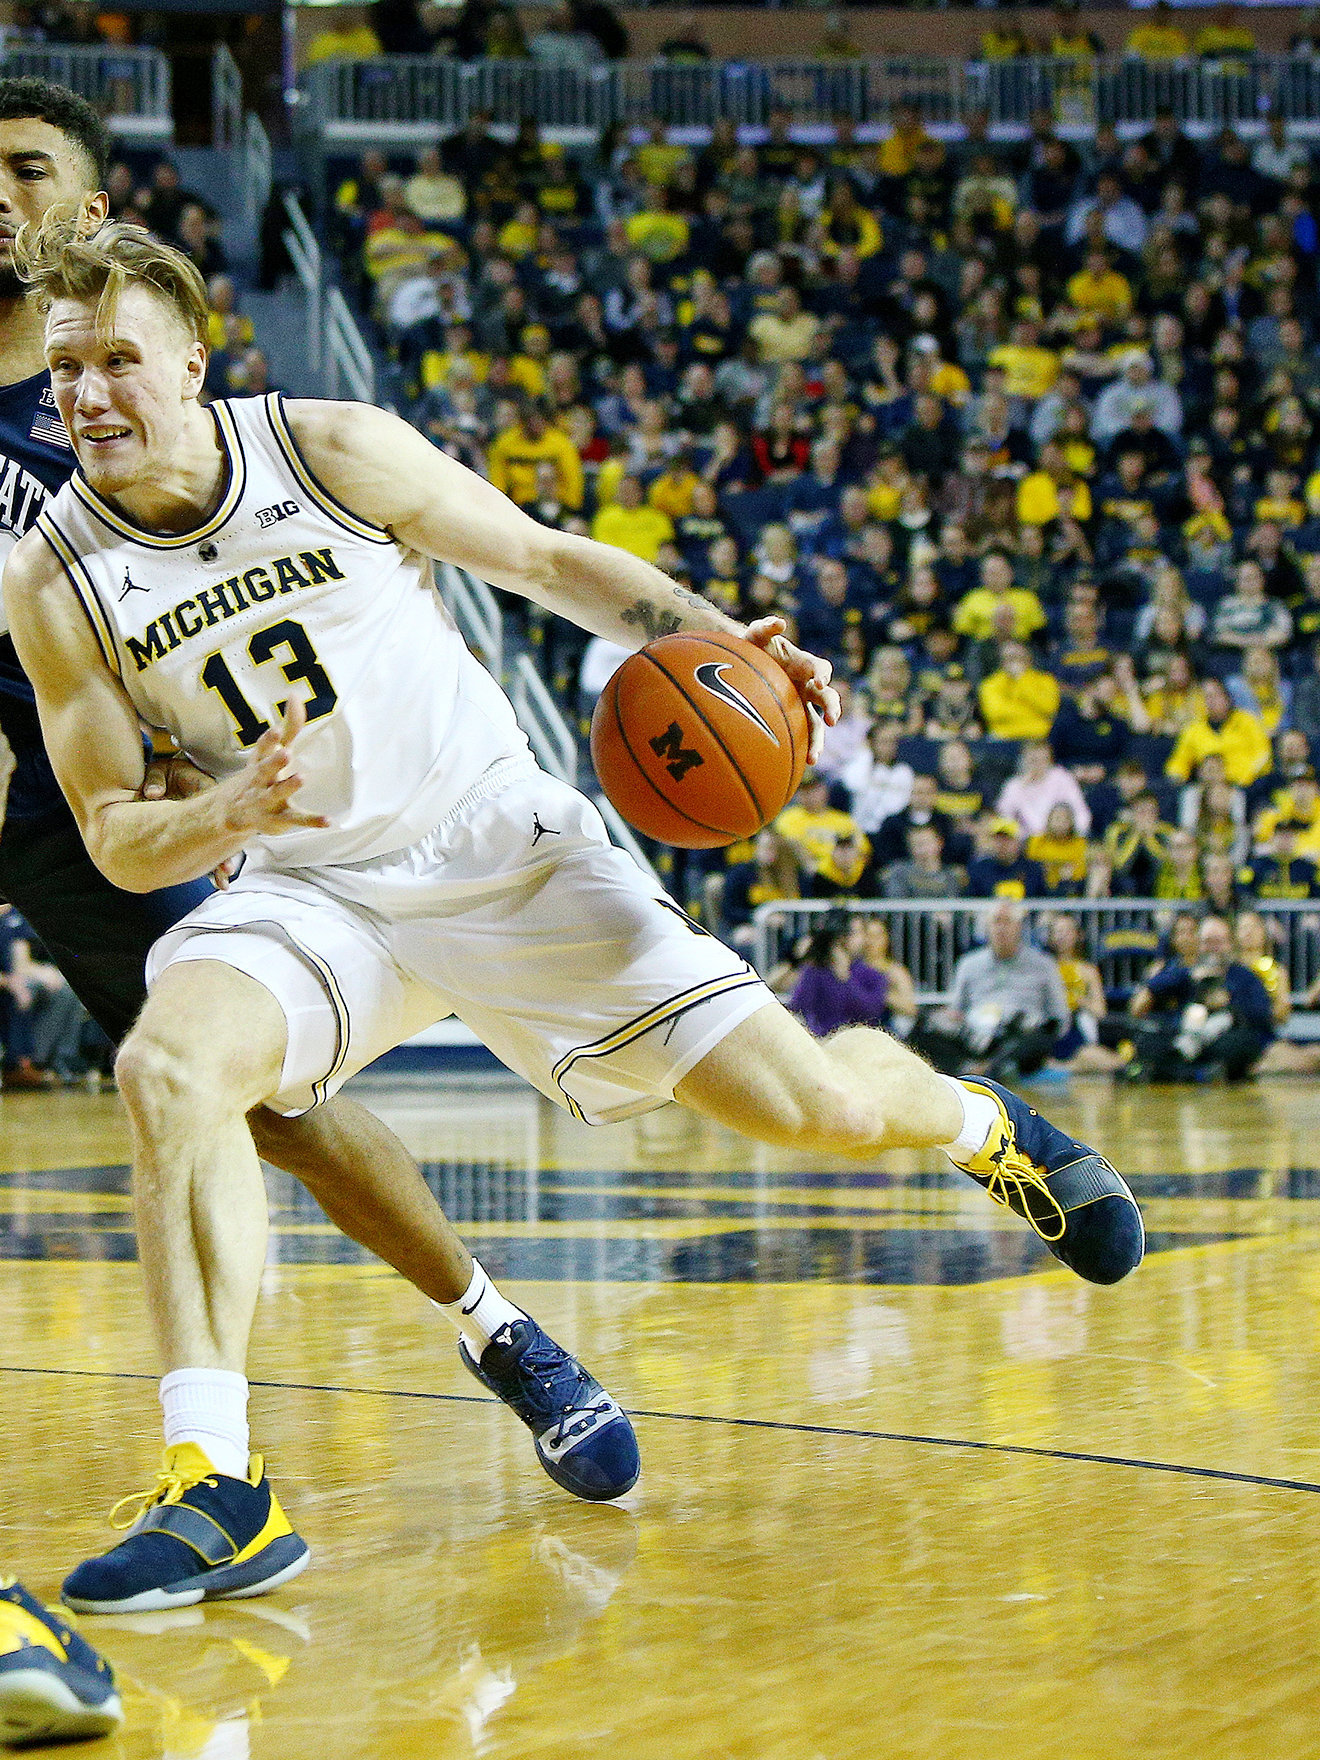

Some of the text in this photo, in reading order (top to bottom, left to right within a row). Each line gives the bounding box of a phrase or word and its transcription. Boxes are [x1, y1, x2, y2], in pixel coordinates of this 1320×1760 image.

[125, 548, 347, 672] MICHIGAN
[199, 618, 338, 749] 13
[649, 721, 705, 783] M
